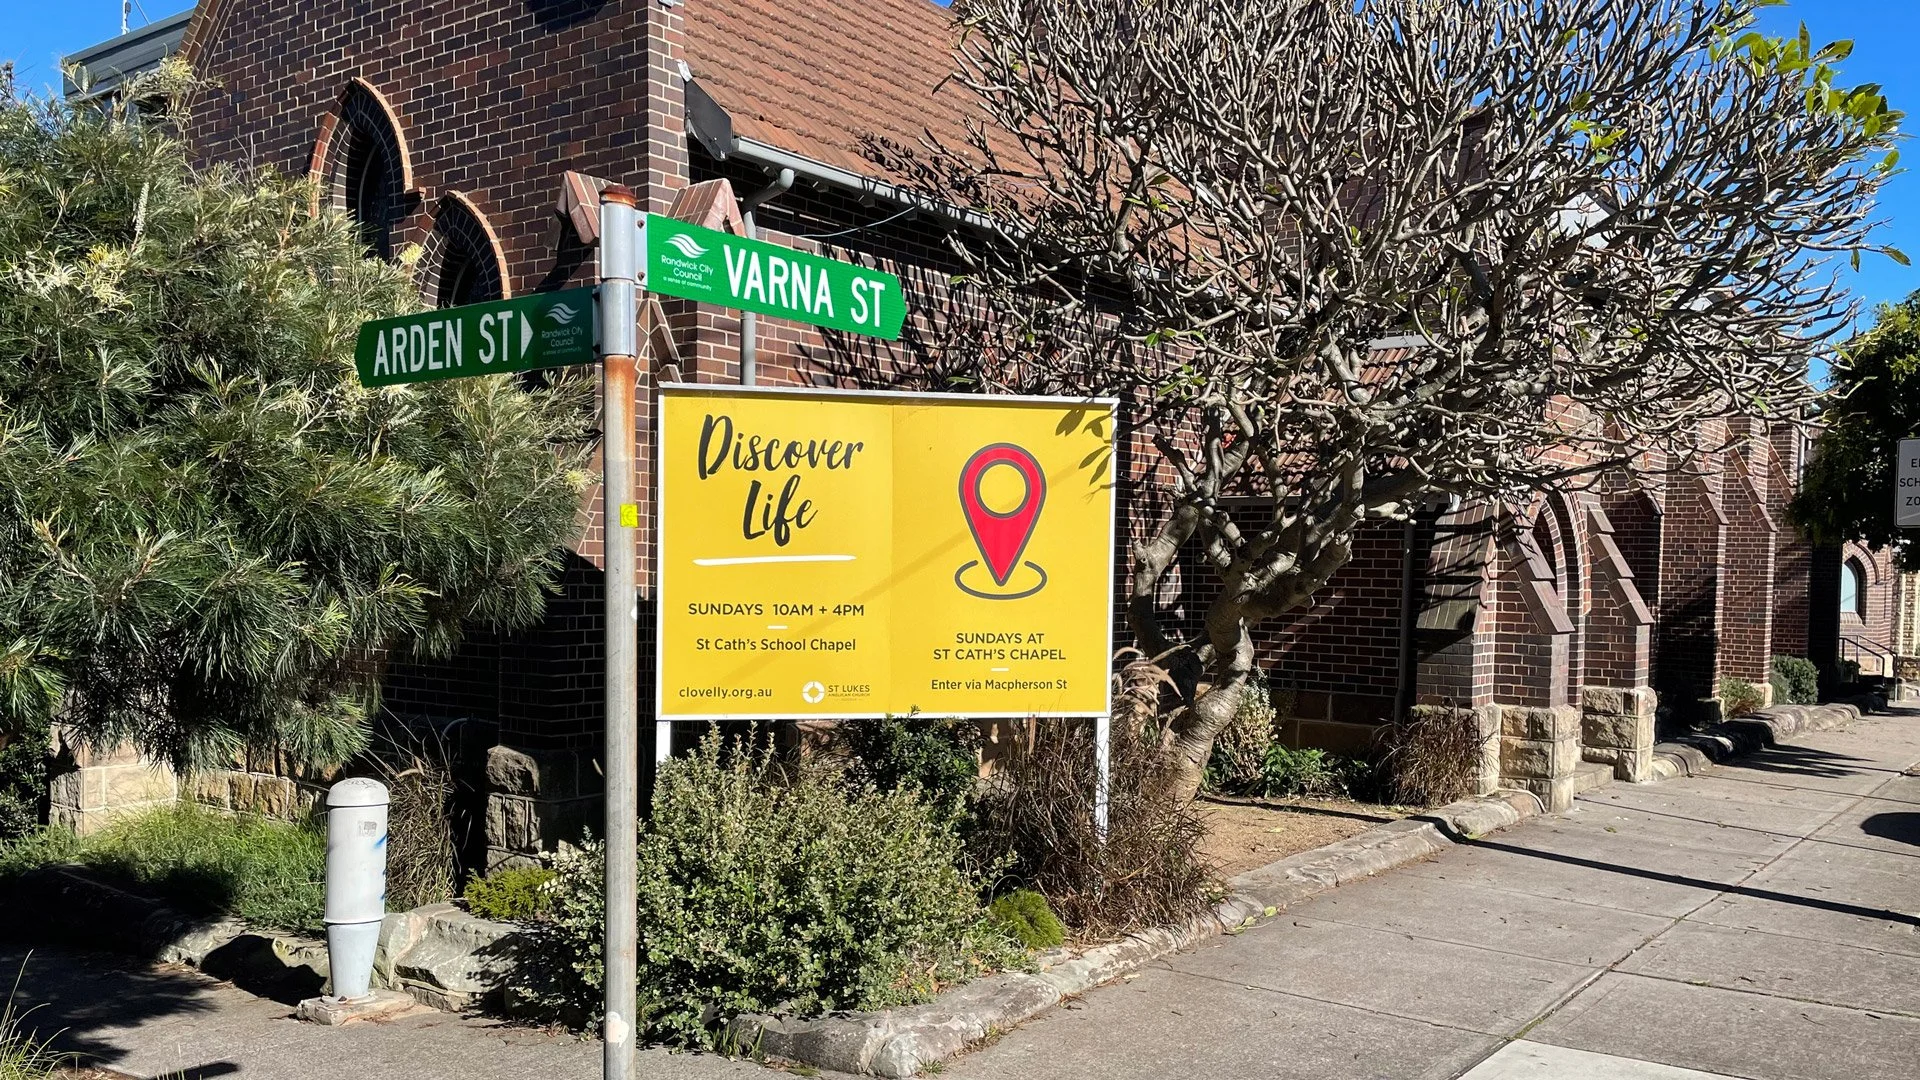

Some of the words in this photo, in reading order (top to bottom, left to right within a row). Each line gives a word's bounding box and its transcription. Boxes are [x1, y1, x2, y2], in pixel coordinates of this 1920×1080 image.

[661, 254, 698, 271] Randwick
[698, 263, 713, 276] City
[673, 267, 703, 282] Council
[723, 244, 834, 318] VARNA
[850, 276, 886, 328] ST
[541, 328, 570, 339] Randwick
[373, 318, 462, 377] ARDEN
[478, 310, 513, 364] ST
[550, 337, 574, 347] Council
[698, 414, 864, 480] Discover
[742, 474, 818, 547] Life
[688, 603, 764, 616] SUNDAYS
[772, 603, 814, 616] 10AM
[819, 606, 828, 615] +
[832, 604, 865, 616] 4PM
[696, 638, 710, 650] St
[714, 638, 757, 650] Cath’s
[760, 638, 806, 651] School
[810, 638, 857, 653] Chapel
[956, 632, 1022, 644] SUNDAYS
[1027, 633, 1044, 644] AT
[933, 649, 951, 660] ST
[955, 649, 1006, 660] CATH’S
[1010, 649, 1066, 660] CHAPEL
[679, 685, 773, 700] clovelly.org.au
[827, 684, 840, 693] ST
[842, 684, 871, 693] LUKES
[931, 679, 962, 690] Enter
[965, 679, 982, 690] via
[985, 679, 1053, 692] Macpherson
[1056, 679, 1068, 690] St
